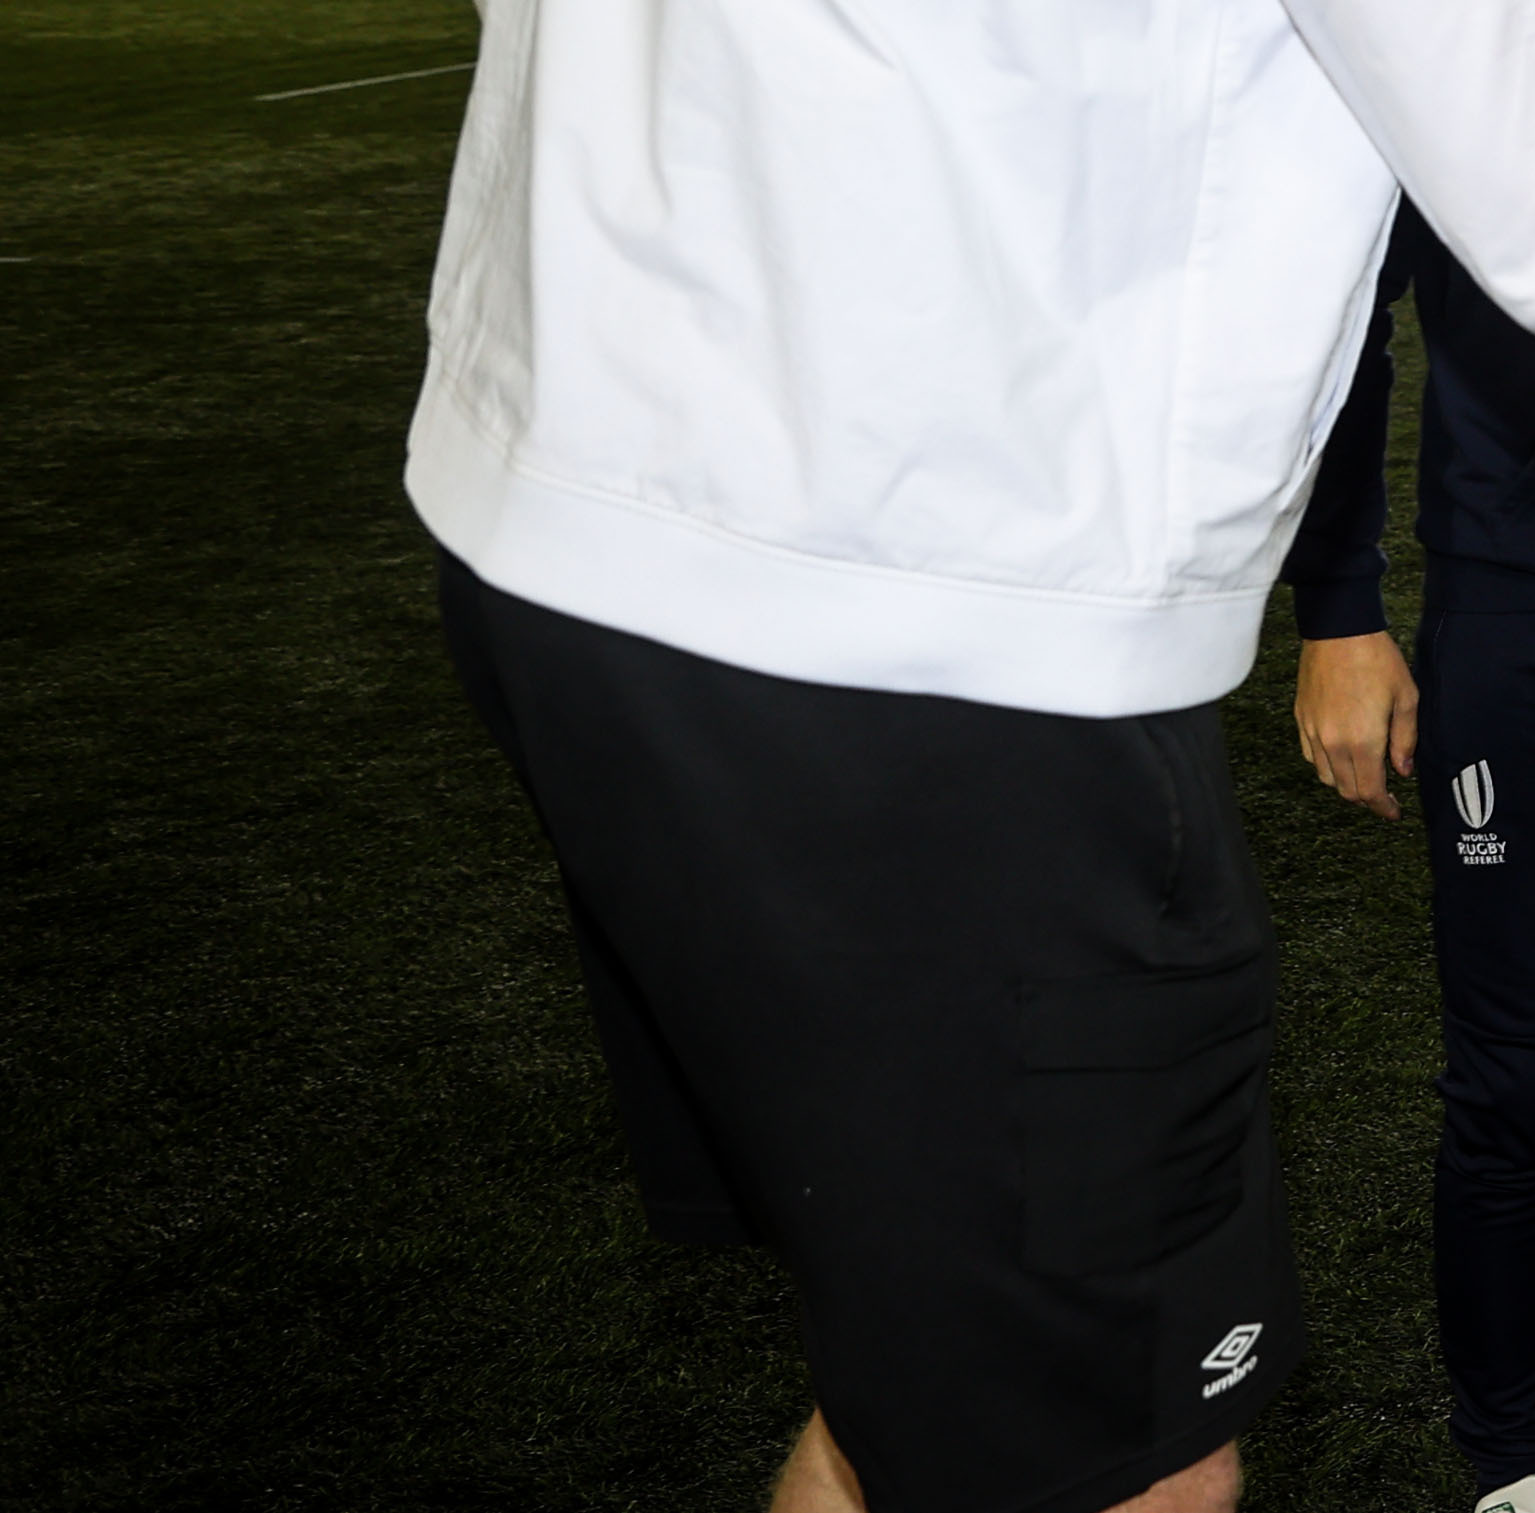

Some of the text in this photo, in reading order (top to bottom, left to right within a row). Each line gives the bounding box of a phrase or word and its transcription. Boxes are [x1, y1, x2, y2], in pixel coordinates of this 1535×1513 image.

[1460, 832, 1497, 842] WORLD
[1456, 841, 1507, 855] RUGBY
[1463, 854, 1506, 865] REFEREE
